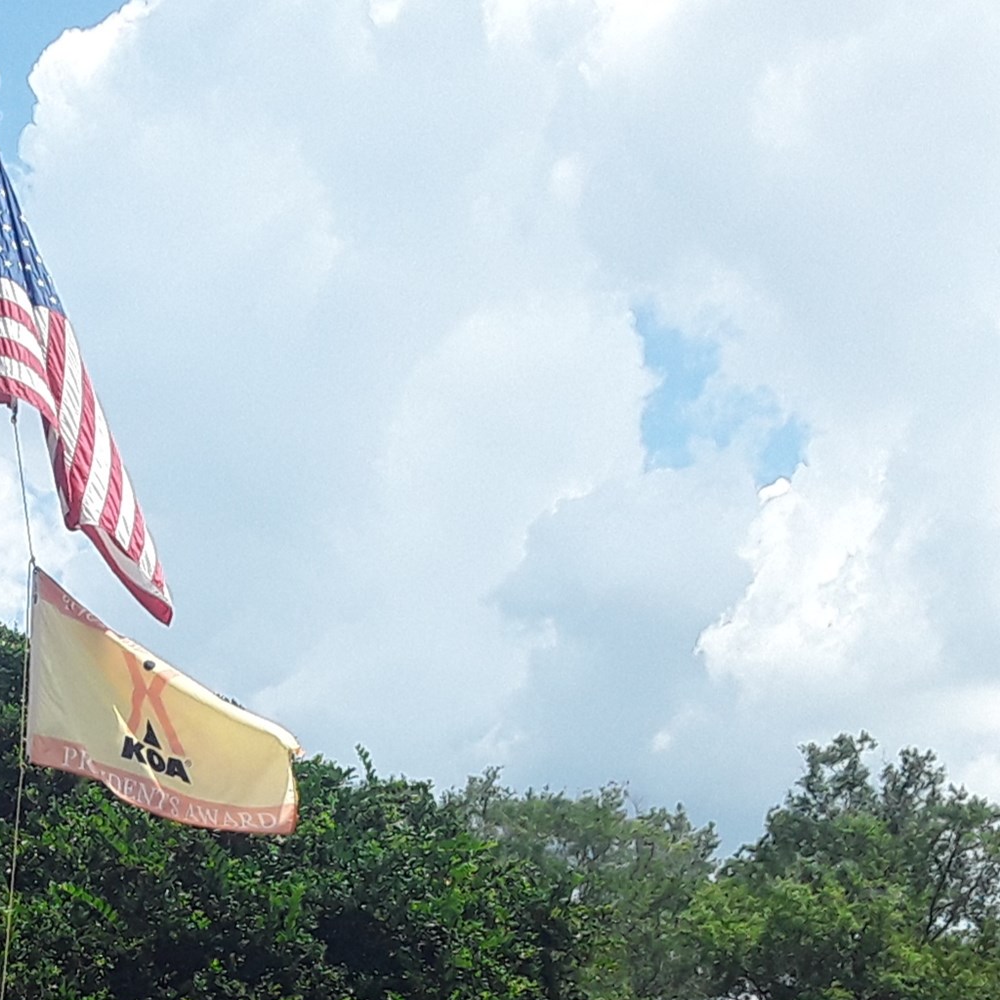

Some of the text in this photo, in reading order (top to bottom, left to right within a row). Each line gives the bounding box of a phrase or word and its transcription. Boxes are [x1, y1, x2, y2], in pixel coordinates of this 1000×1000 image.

[61, 746, 276, 829] PRDENT'S AWARD
[121, 736, 191, 784] KOA
